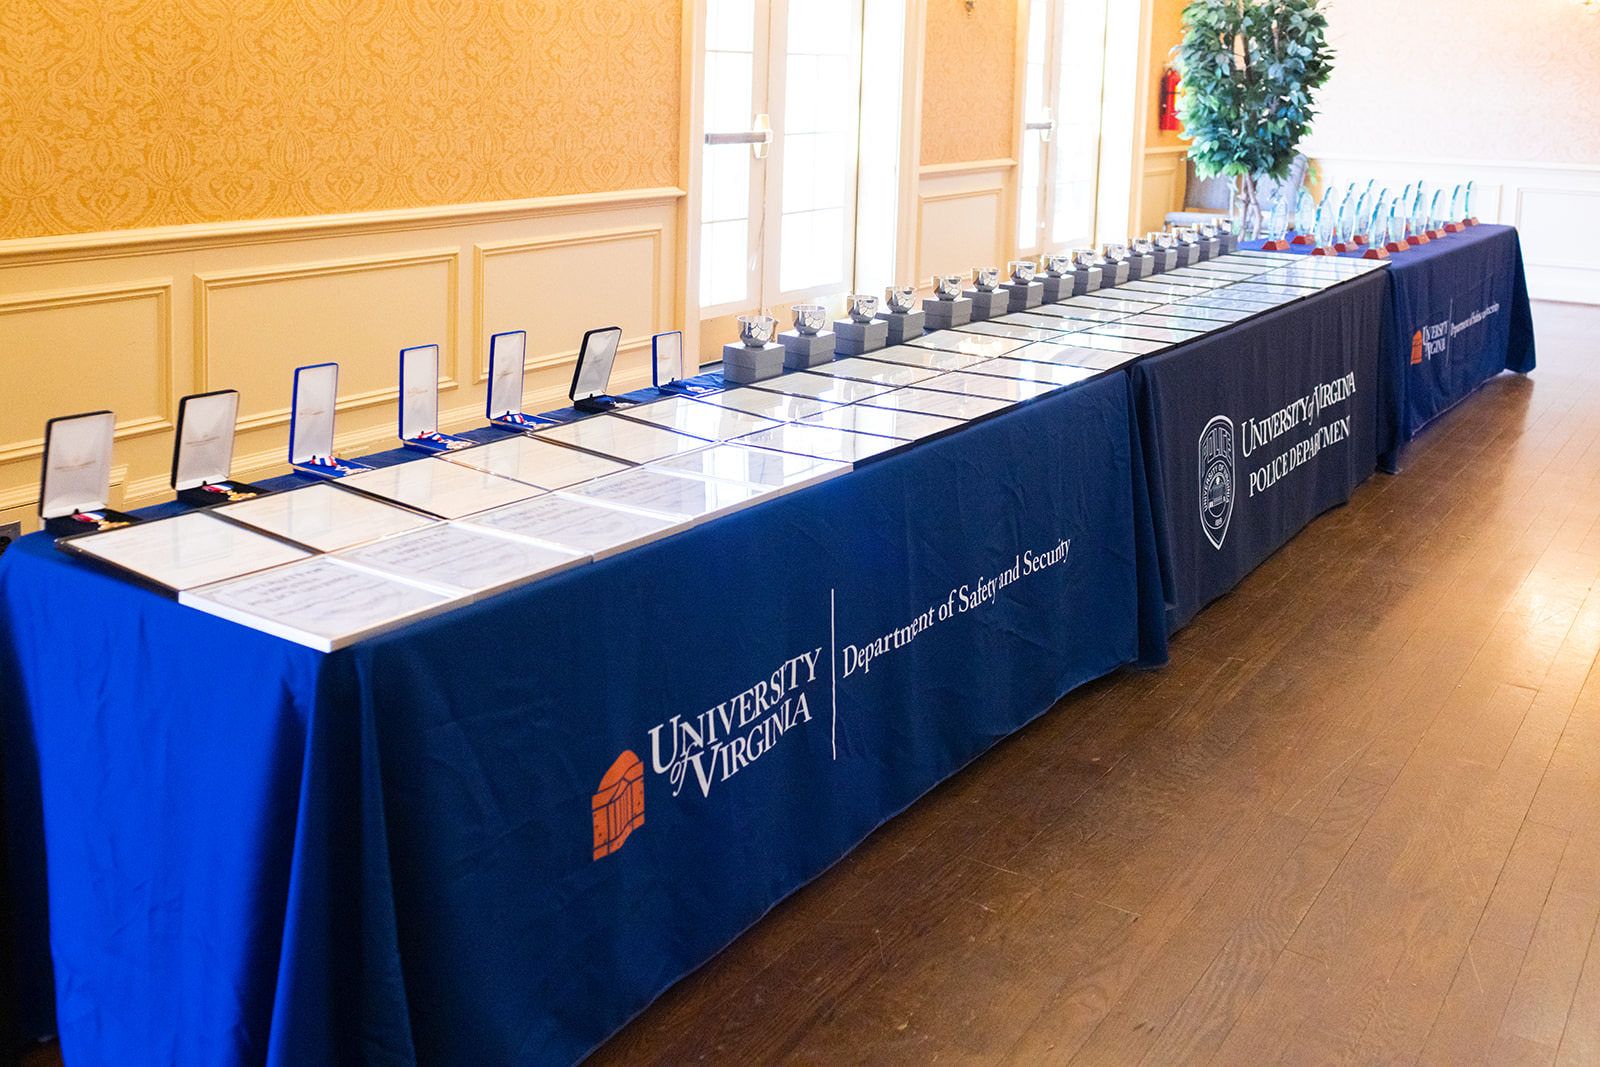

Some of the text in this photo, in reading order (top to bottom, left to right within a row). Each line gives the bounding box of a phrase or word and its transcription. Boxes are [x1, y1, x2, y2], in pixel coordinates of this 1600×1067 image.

[1241, 396, 1309, 458] UNIVERSITY
[1314, 371, 1357, 417] VIRGINA
[1249, 415, 1351, 498] POLICE DEPARTMEN
[842, 538, 1071, 679] Department of Safety and Security
[647, 647, 822, 775] UNIVERSITY
[670, 691, 813, 798] of VIRGINIA
